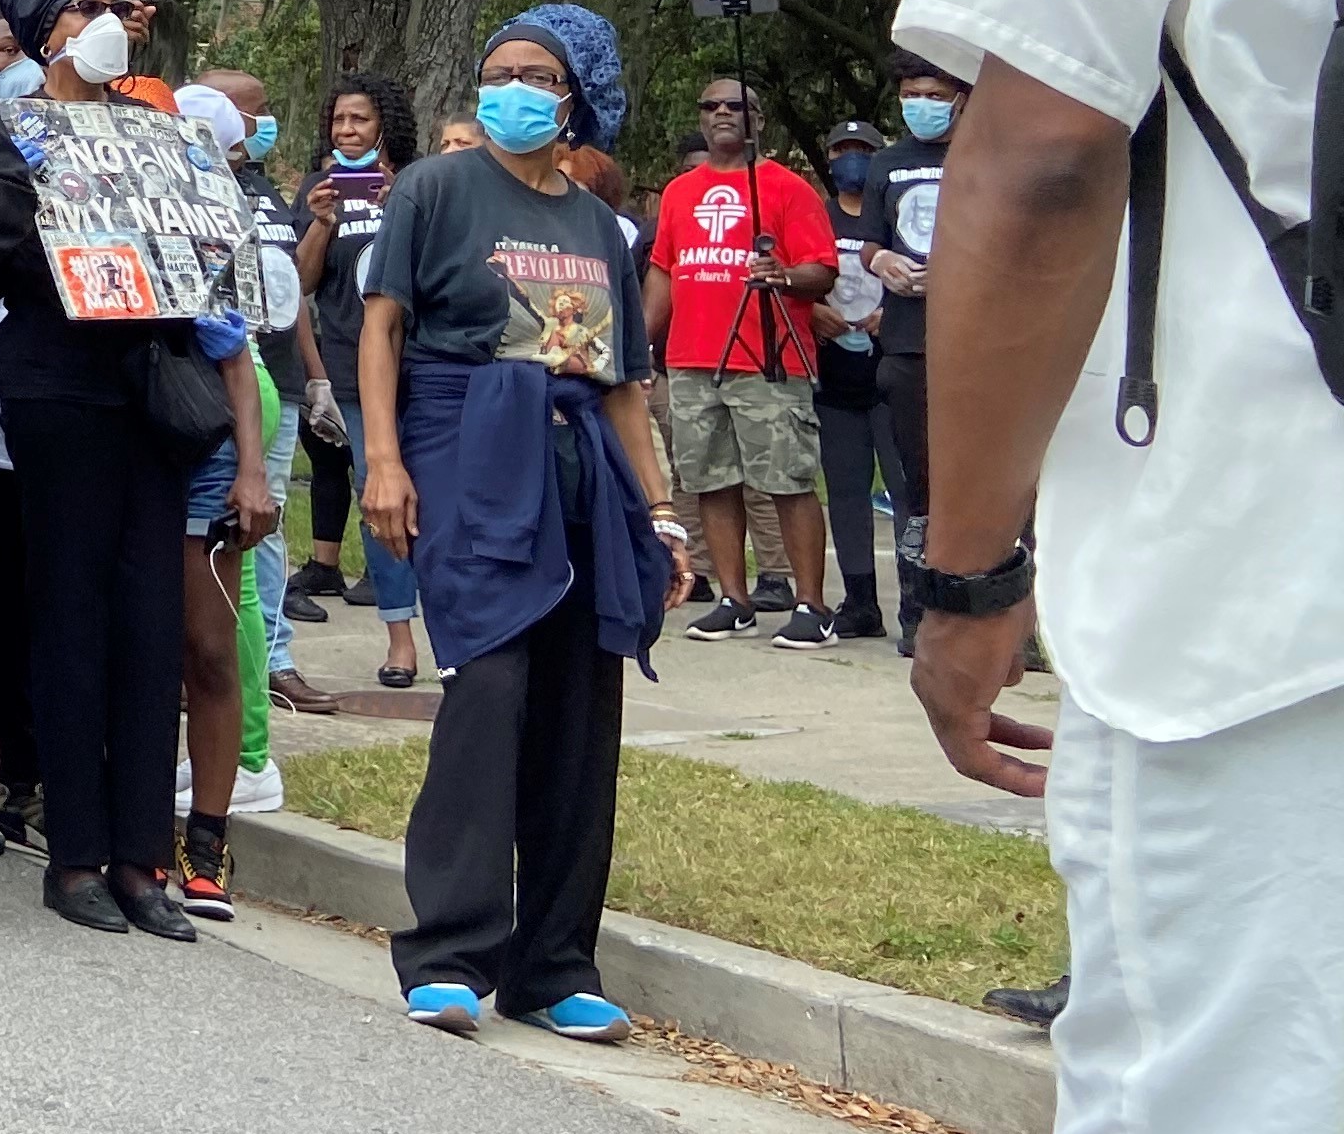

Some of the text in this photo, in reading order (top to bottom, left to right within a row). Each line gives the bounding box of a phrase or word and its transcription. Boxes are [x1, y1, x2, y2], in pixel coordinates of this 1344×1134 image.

[62, 135, 191, 183] NOT IN
[51, 196, 243, 243] MY NAME!
[504, 253, 609, 286] REVOLUTION
[694, 267, 732, 283] church
